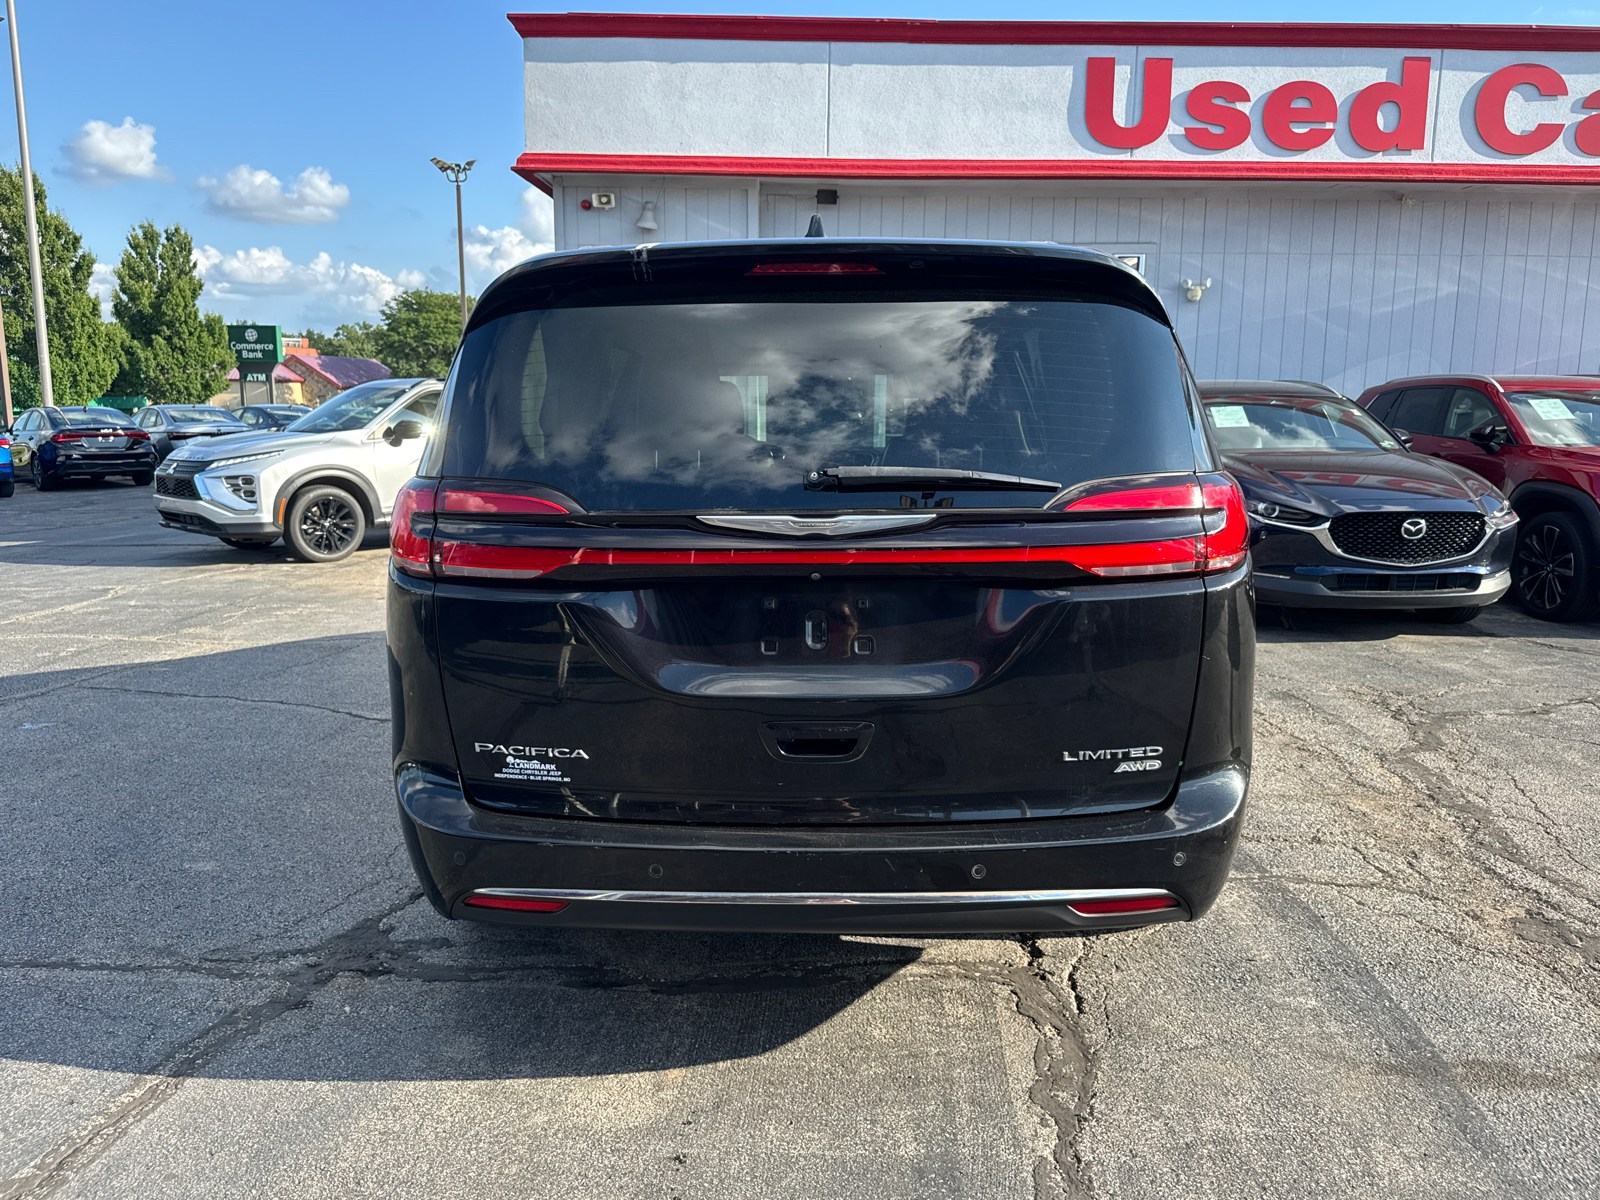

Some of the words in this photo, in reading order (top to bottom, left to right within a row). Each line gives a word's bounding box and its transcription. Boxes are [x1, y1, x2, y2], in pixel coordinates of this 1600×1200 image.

[1085, 57, 1432, 151] Used
[230, 341, 274, 350] Commerce
[242, 350, 263, 358] Bank
[246, 373, 267, 381] ATM
[474, 742, 589, 760] PACIFICA
[1062, 746, 1163, 761] LIMITED
[514, 762, 557, 771] LANDMARK
[1113, 760, 1162, 773] AWD
